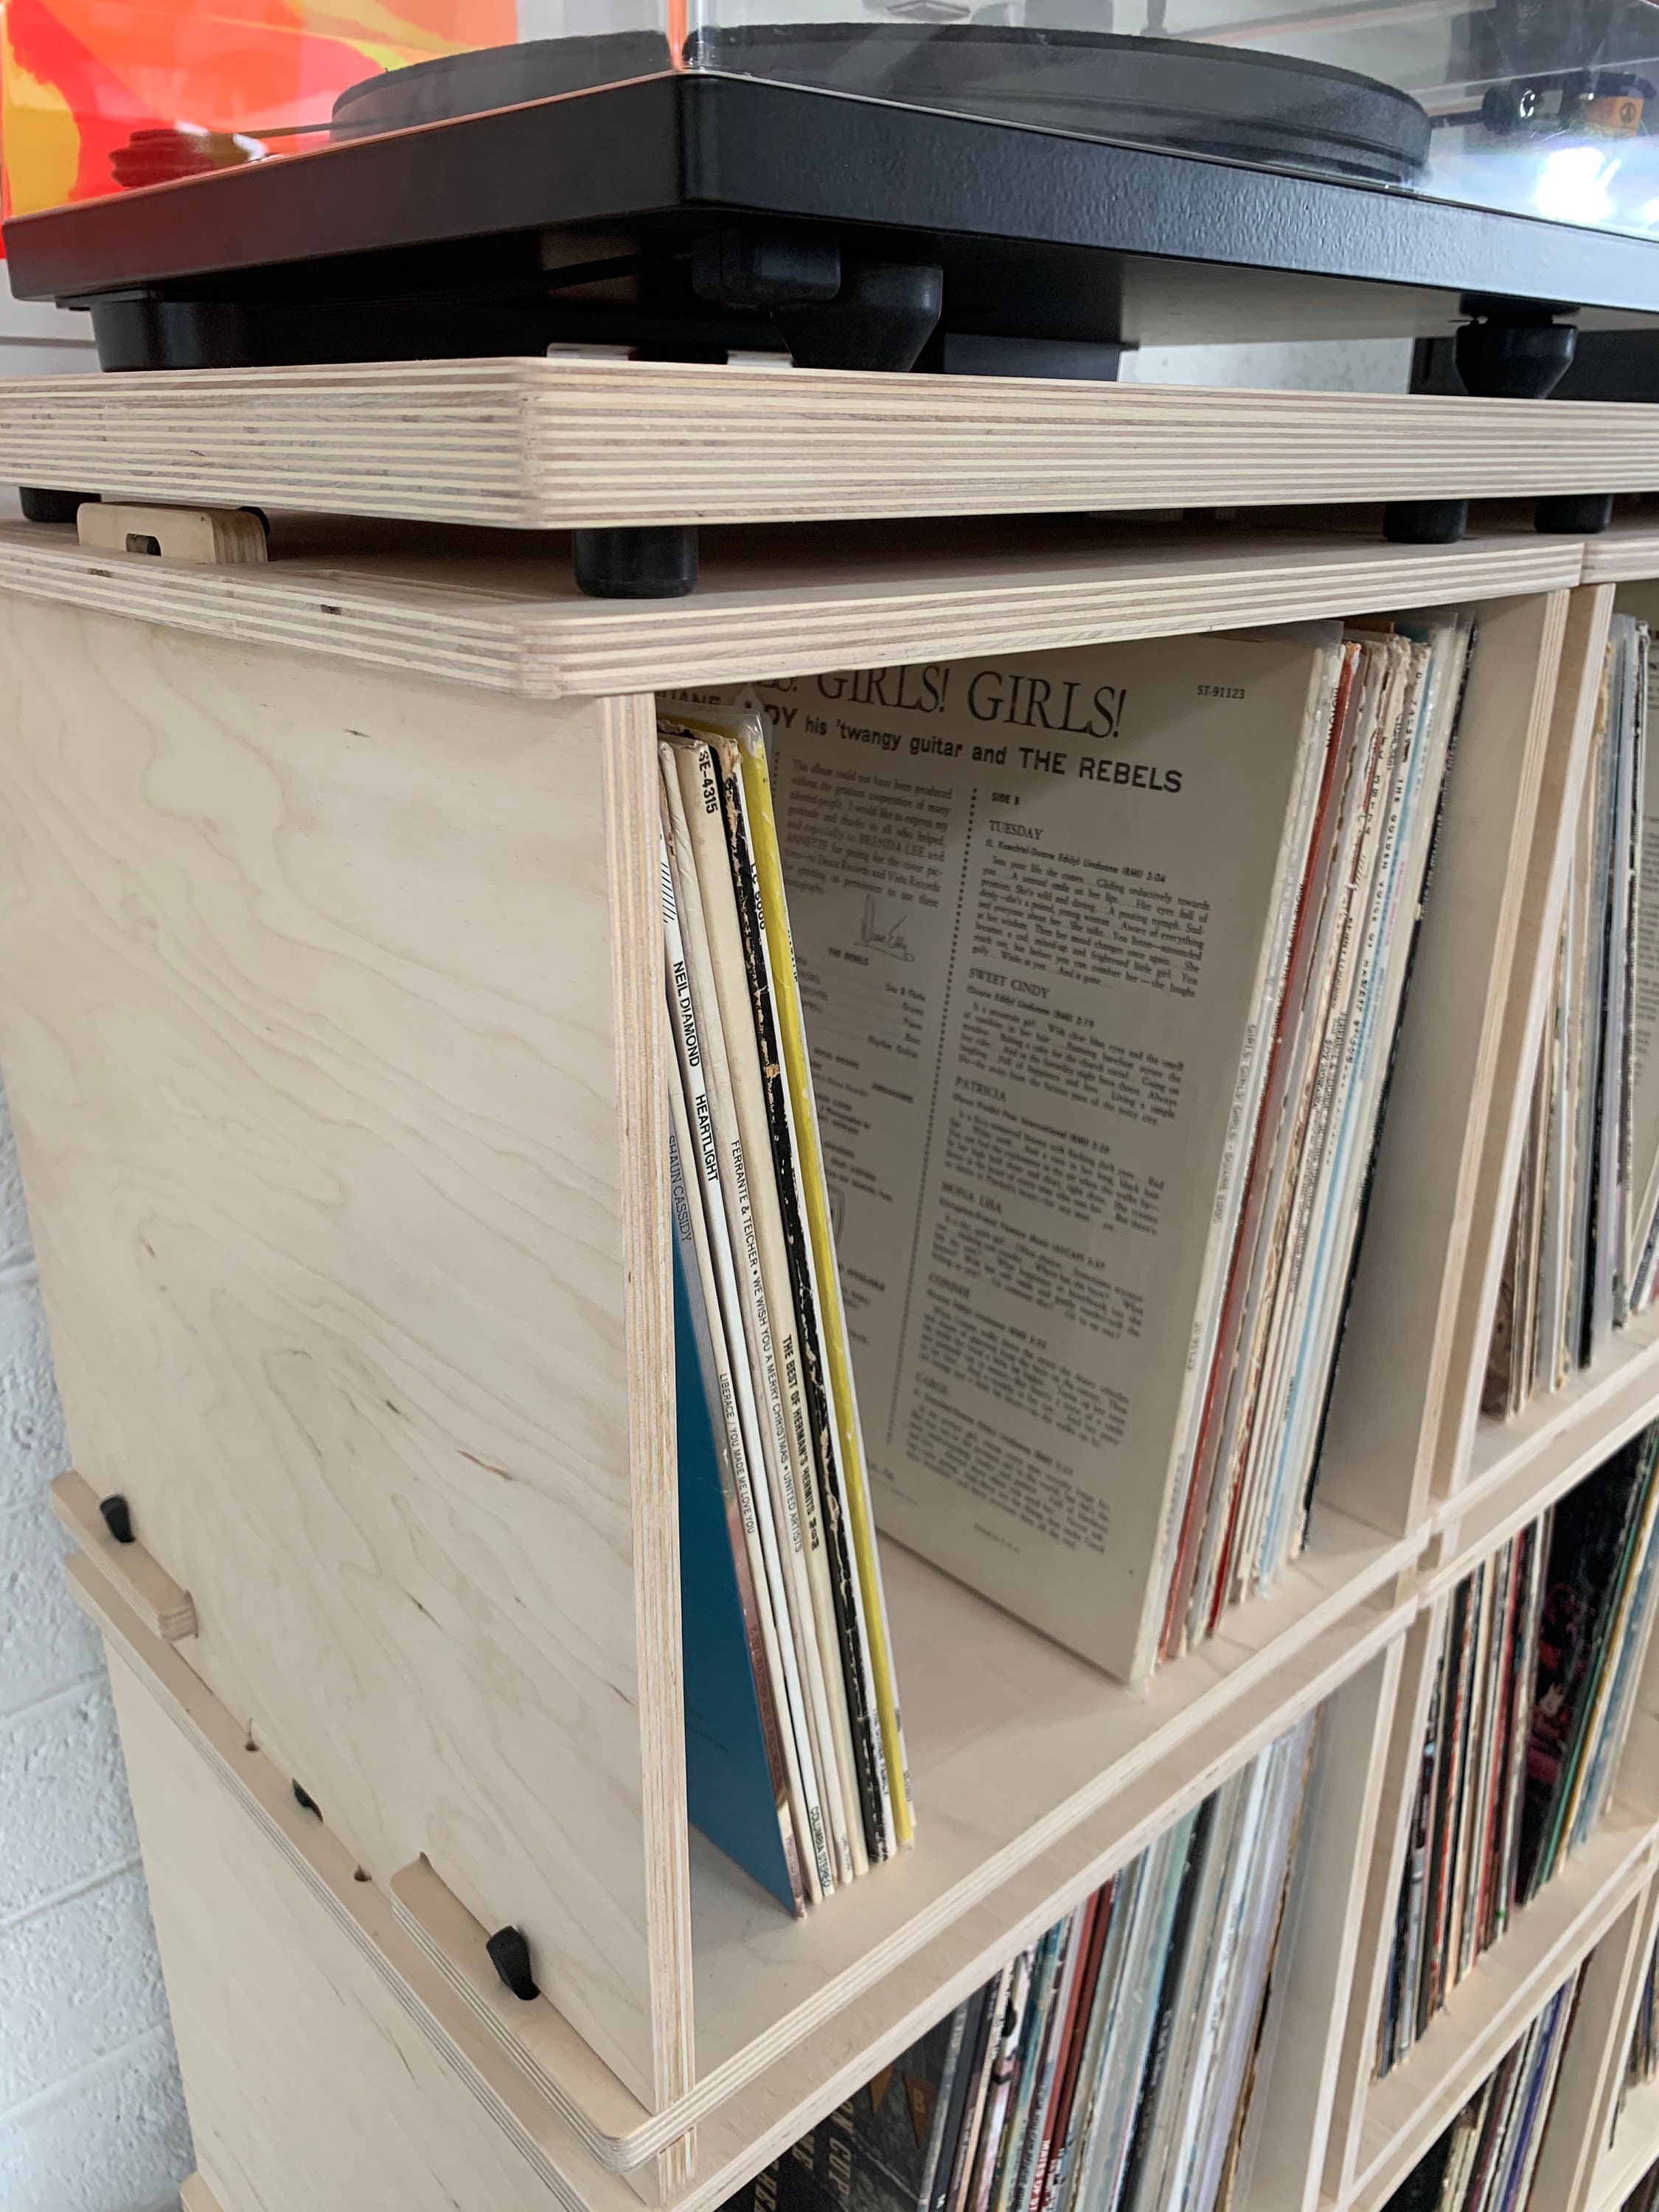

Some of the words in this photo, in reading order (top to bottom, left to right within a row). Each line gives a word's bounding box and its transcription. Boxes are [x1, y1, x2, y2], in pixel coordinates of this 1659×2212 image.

[967, 670, 1127, 738] GIRLS!
[1197, 685, 1245, 699] ST-91123
[805, 715, 827, 736] his
[837, 719, 901, 751] 'twangy
[909, 736, 963, 758] guitar
[971, 745, 1006, 765] and
[1020, 747, 1068, 774] THE
[1079, 757, 1183, 793] REBELS
[699, 751, 718, 814] SE-4315
[990, 821, 1044, 840] TUESDAY
[672, 961, 689, 998] NEIL
[968, 967, 1007, 987] SWEET
[1010, 979, 1051, 999] CINDY
[680, 998, 700, 1068] DIAMOND
[695, 1093, 719, 1183] HEARTLIGHT
[668, 1135, 682, 1184] SHAUN
[731, 1140, 749, 1205] FERRANTE
[673, 1186, 692, 1242] CASSIDY
[740, 1206, 751, 1216] &
[742, 1215, 759, 1267] TEICHER
[753, 1276, 762, 1295] WE
[755, 1295, 768, 1326] WISH
[760, 1326, 771, 1351] YOU
[782, 1335, 794, 1359] THE
[765, 1354, 773, 1364] A
[785, 1360, 798, 1388] BEST
[719, 1373, 735, 1419] LIBERACE
[767, 1364, 780, 1400] MERRY
[790, 1389, 801, 1407] OF
[727, 1424, 739, 1448] YOU
[772, 1402, 789, 1464] CHRISTMAS
[793, 1407, 809, 1466] HERMAN'S
[733, 1449, 744, 1475] MADE
[737, 1475, 748, 1489] ME
[801, 1467, 815, 1516] HERMITS
[740, 1489, 752, 1514] LOVE
[783, 1471, 796, 1511] UNITED
[790, 1513, 804, 1553] ARTISTS
[745, 1514, 756, 1534] YOU
[828, 2136, 852, 2195] CUP
